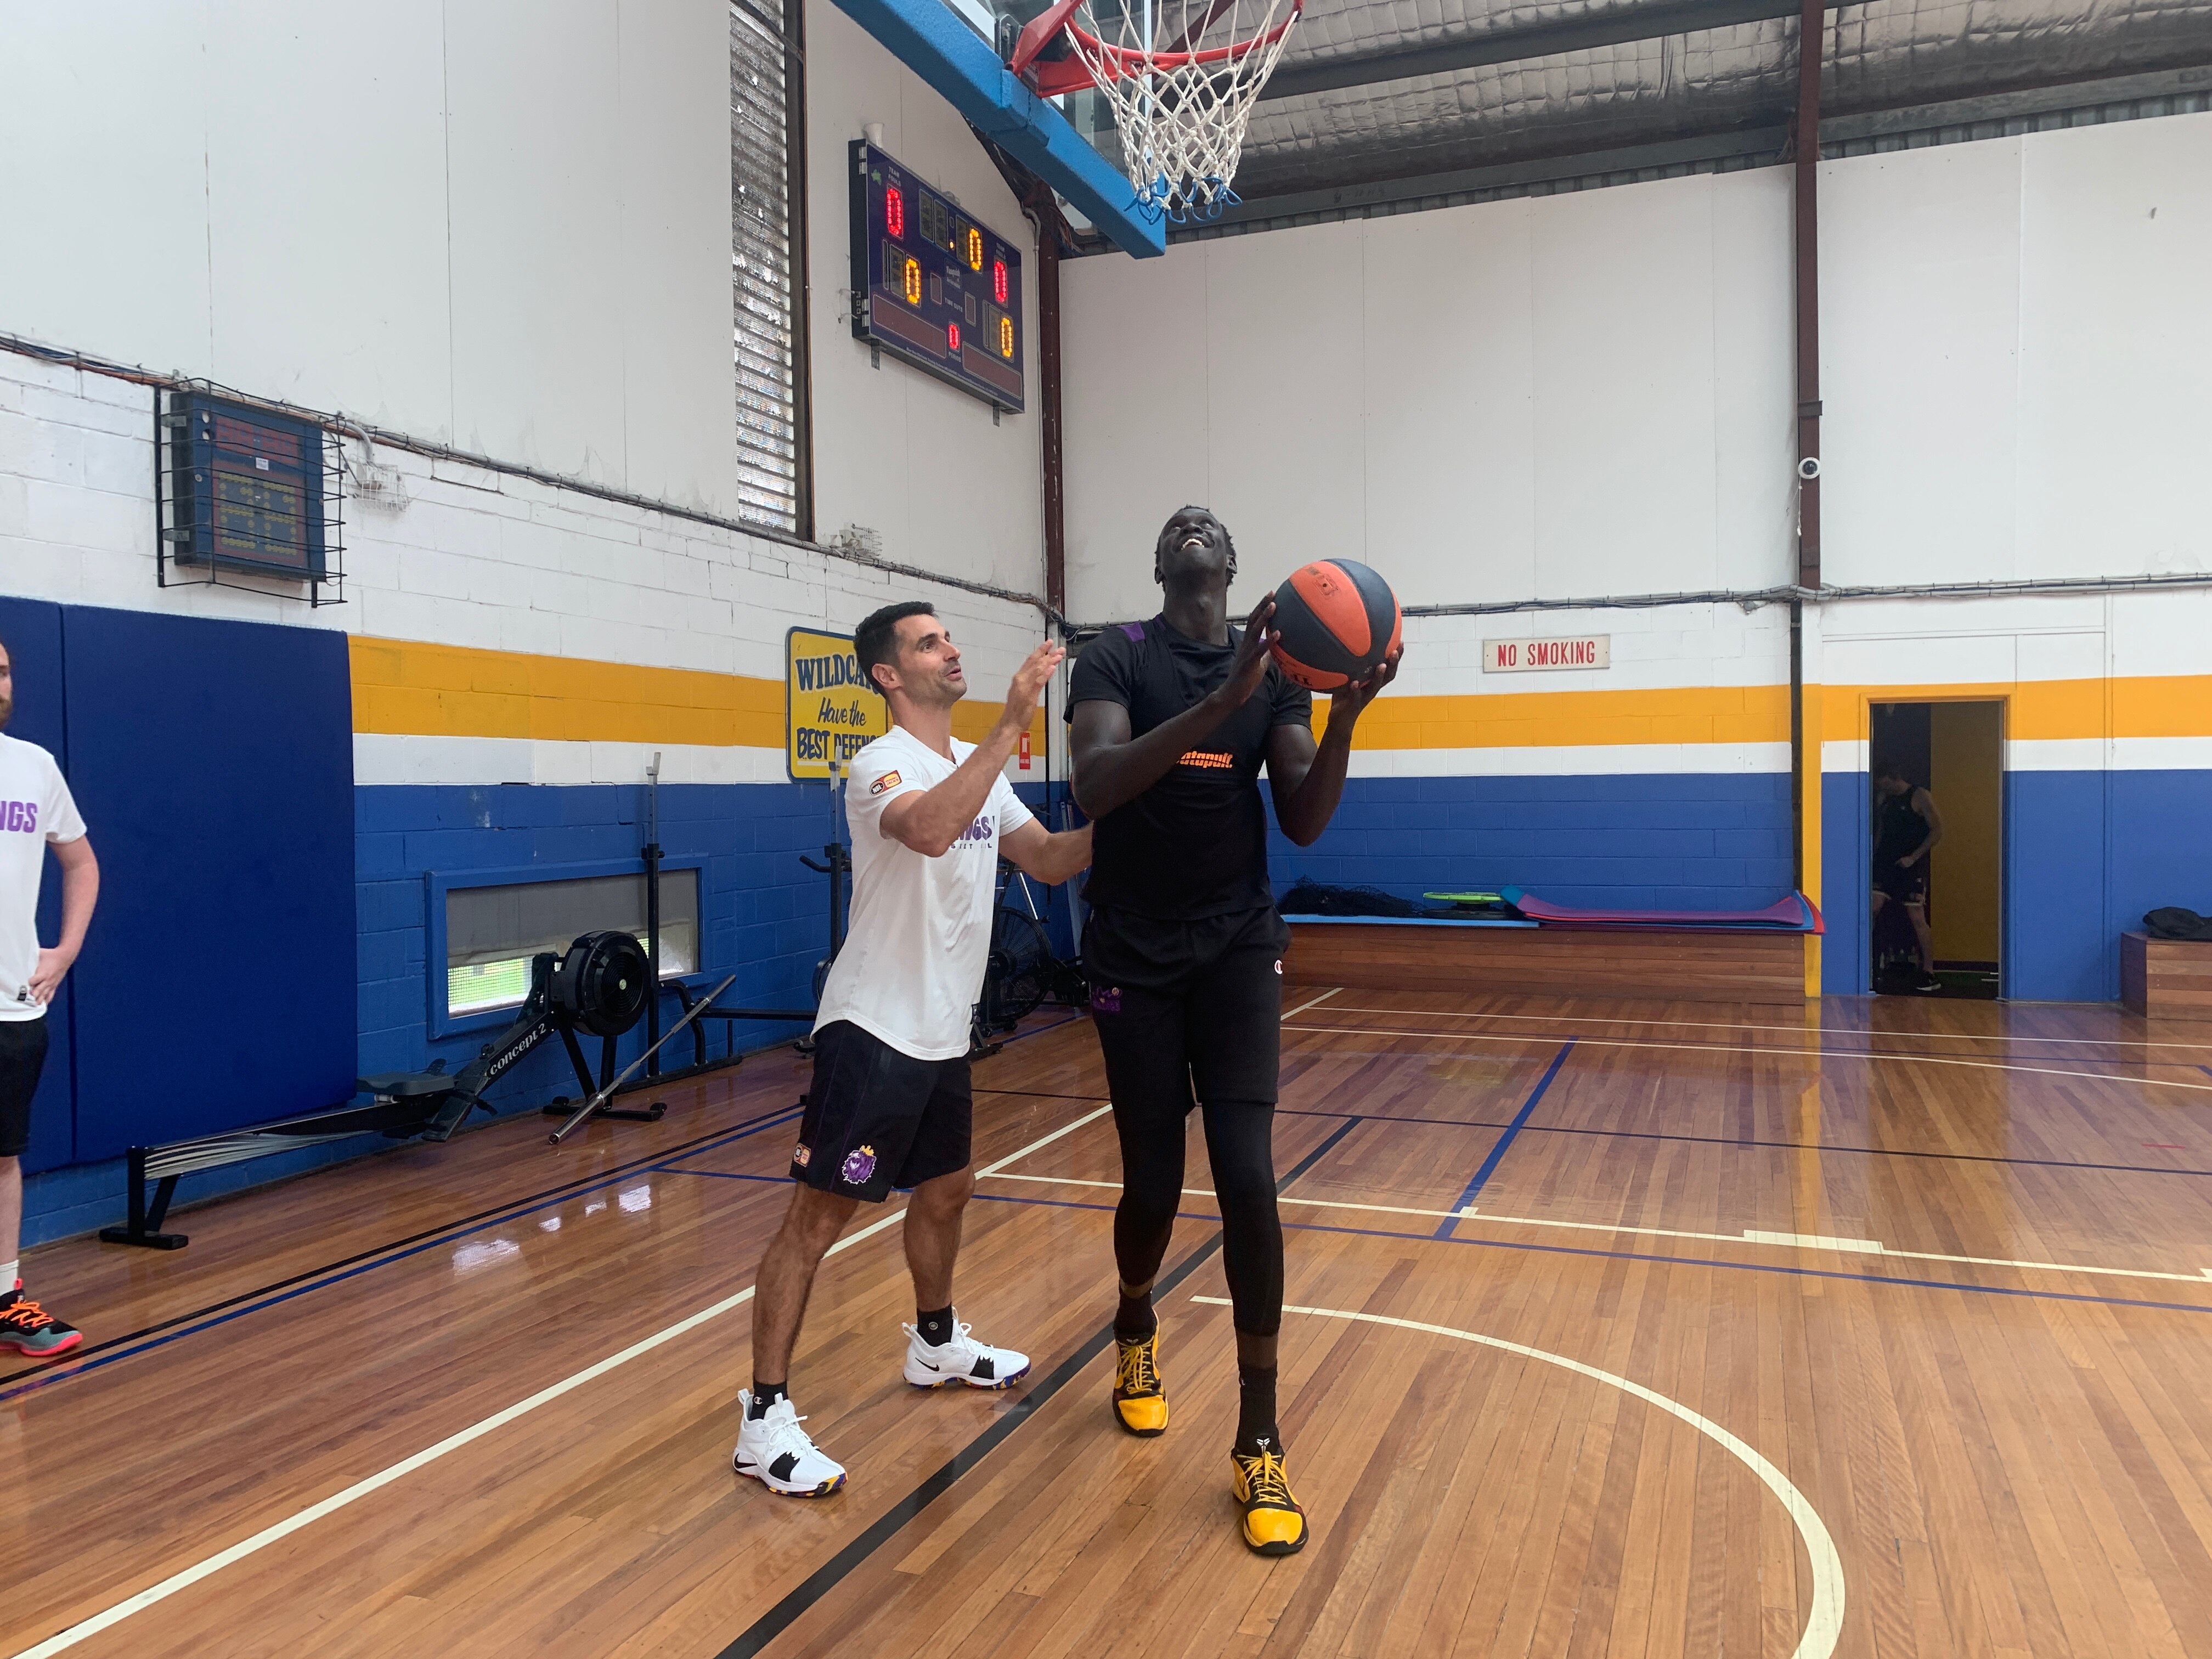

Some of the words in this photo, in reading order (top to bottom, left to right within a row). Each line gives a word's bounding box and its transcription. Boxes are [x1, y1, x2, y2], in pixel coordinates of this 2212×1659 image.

[889, 166, 900, 178] TEAM
[1498, 644, 1516, 667] NO
[1527, 641, 1595, 665] SMOKING
[795, 654, 879, 694] WILDCA
[817, 697, 848, 724] Have
[849, 699, 866, 727] the
[797, 727, 830, 760] BEST
[872, 784, 882, 793] NBL
[490, 1030, 538, 1075] concept
[538, 1023, 546, 1035] 2
